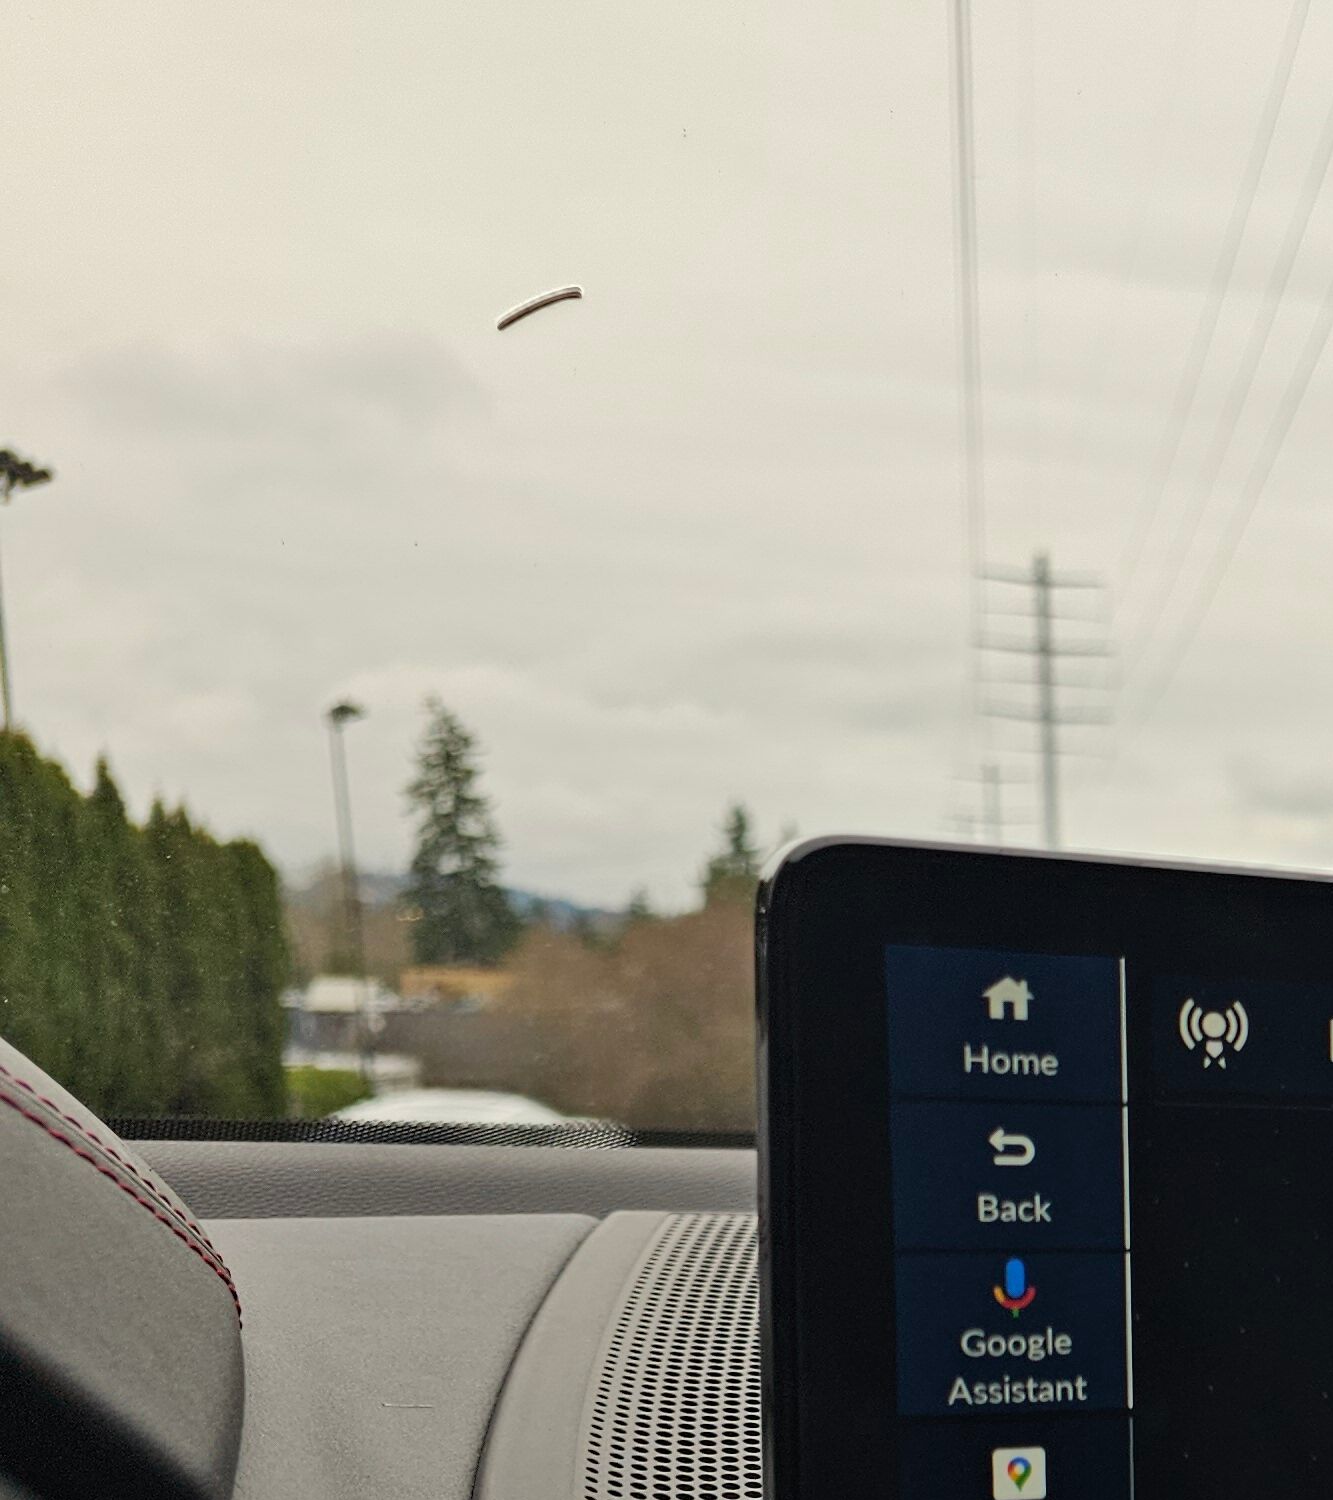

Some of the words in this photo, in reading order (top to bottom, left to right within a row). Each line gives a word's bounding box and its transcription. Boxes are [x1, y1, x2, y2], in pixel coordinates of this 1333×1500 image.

[963, 1043, 1058, 1077] Home
[977, 1193, 1052, 1224] Back
[960, 1328, 1072, 1361] Google
[948, 1376, 1087, 1405] Assistant
